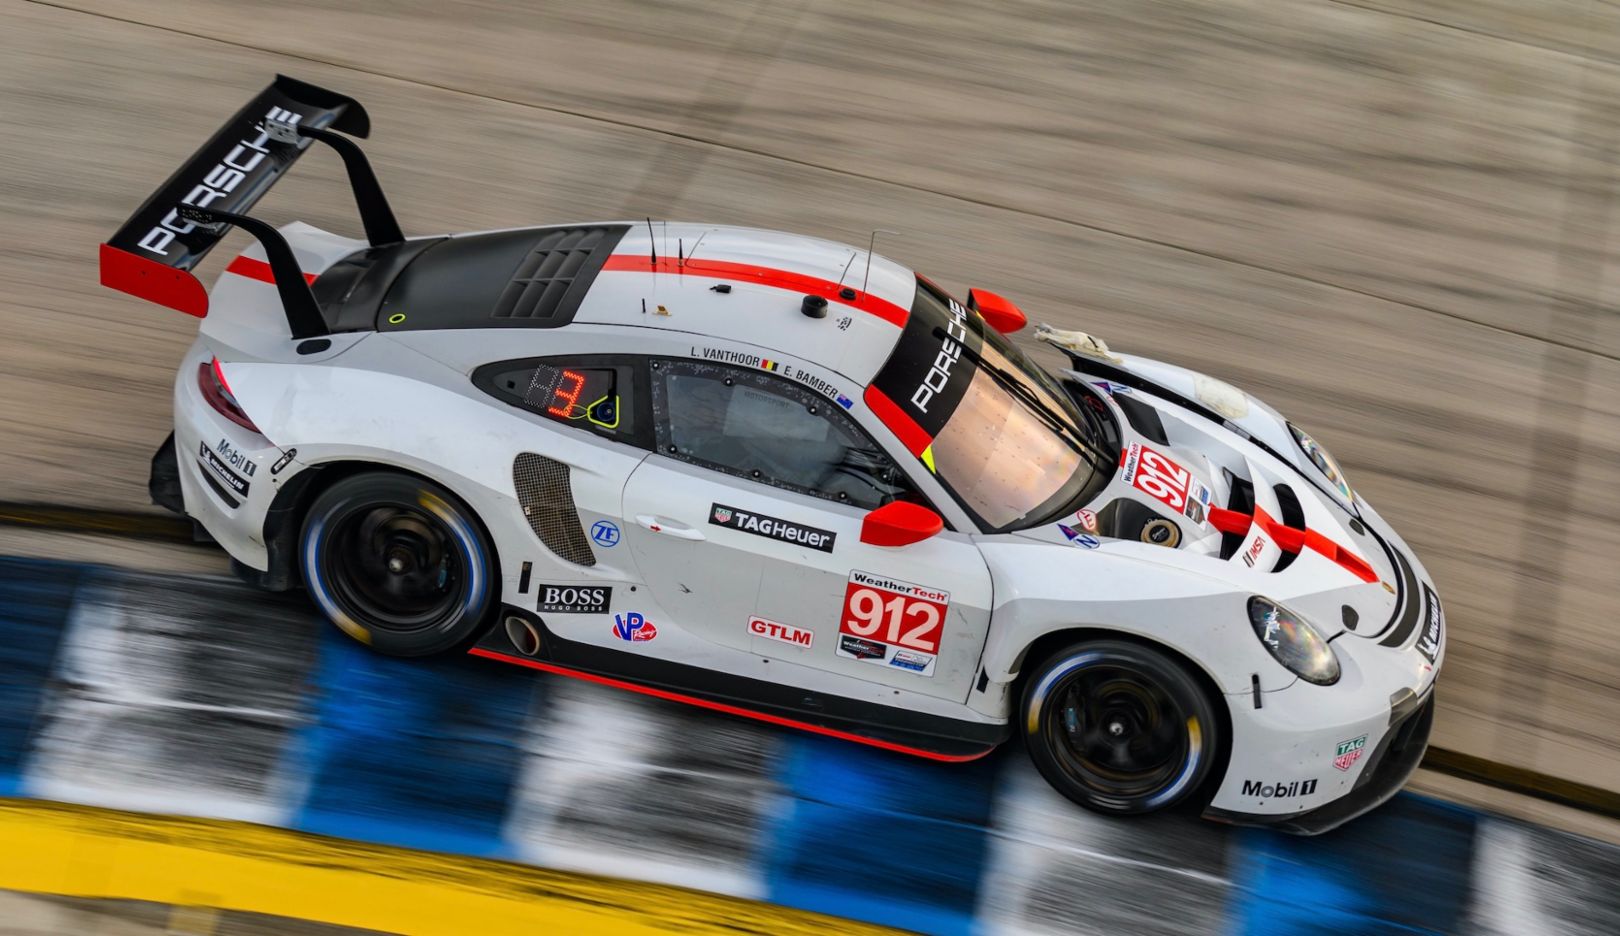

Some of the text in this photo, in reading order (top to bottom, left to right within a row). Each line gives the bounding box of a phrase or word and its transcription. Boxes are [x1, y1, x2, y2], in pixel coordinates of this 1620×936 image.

[690, 346, 761, 368] L. VANTHOOR
[783, 365, 838, 398] E. BAMBER
[216, 438, 246, 470] Mobil
[1137, 450, 1189, 508] 912
[594, 527, 617, 541] ZF
[544, 587, 605, 606] BOSS
[854, 572, 946, 601] WeatherTech
[614, 612, 644, 641] VP
[750, 620, 811, 646] GTLM
[847, 588, 940, 651] 912
[1339, 738, 1365, 754] TAG
[1241, 780, 1299, 798] Mobil
